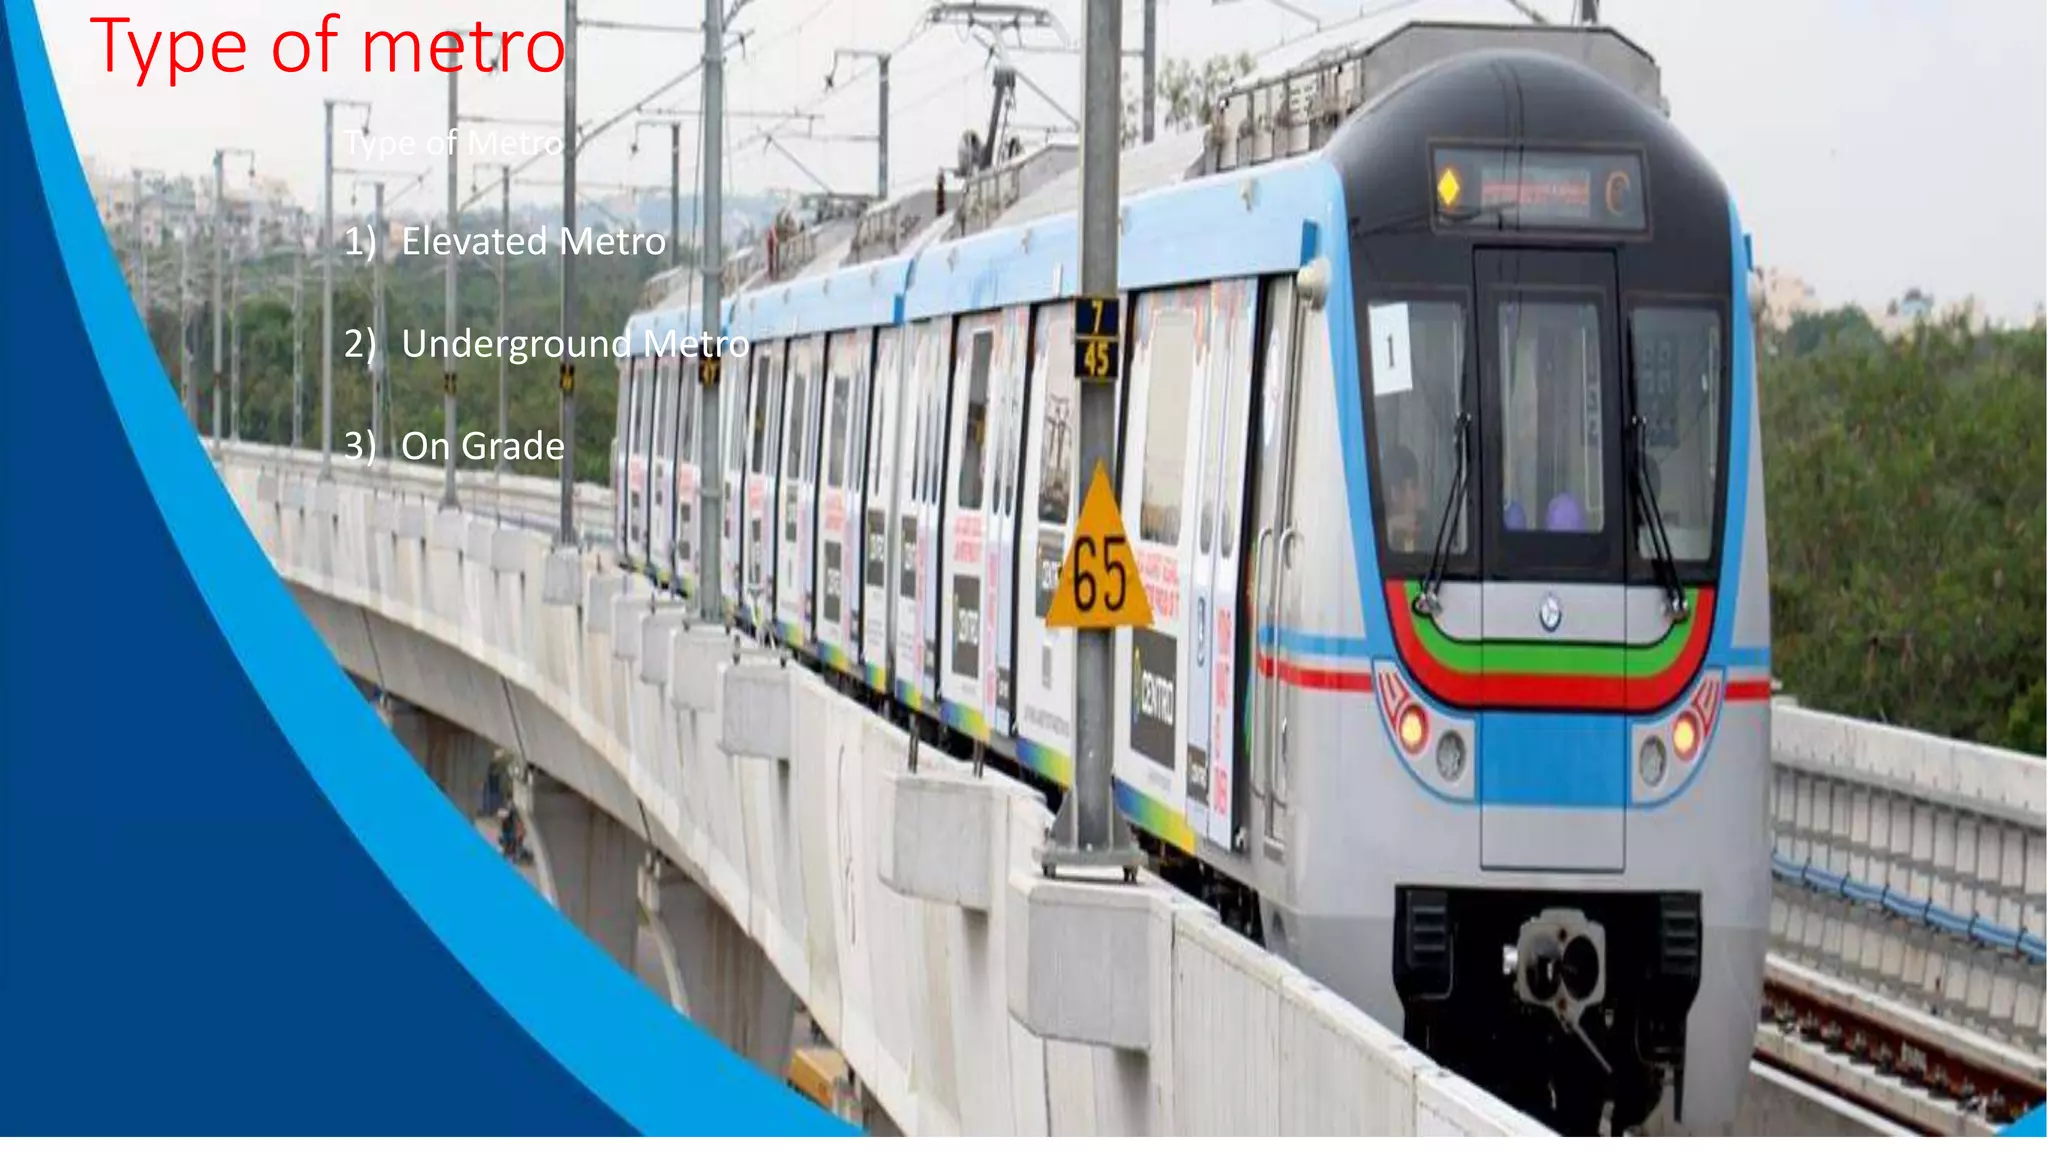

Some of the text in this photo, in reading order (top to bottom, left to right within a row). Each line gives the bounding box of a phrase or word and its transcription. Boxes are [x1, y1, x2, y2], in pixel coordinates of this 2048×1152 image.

[1091, 299, 1104, 334] 7
[1084, 341, 1109, 377] 45
[1385, 332, 1396, 369] 1
[1073, 536, 1126, 612] 65
